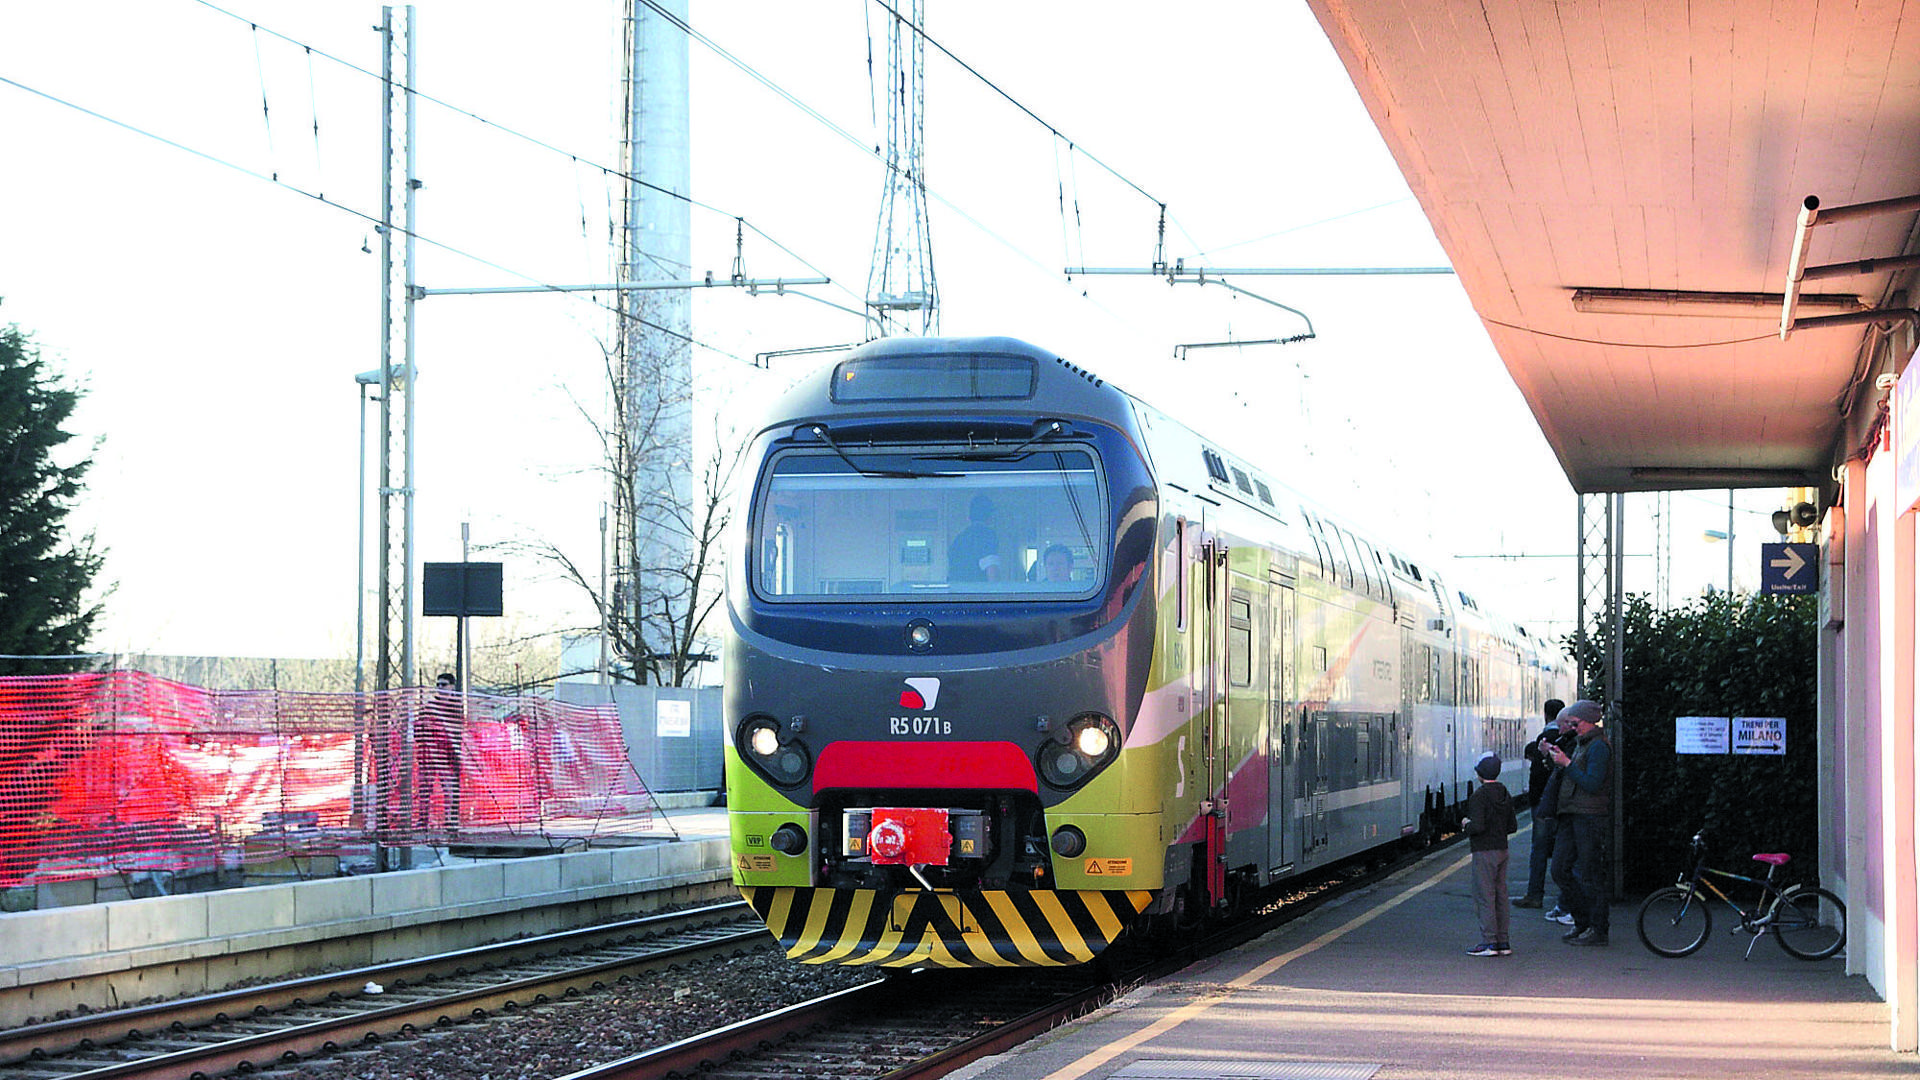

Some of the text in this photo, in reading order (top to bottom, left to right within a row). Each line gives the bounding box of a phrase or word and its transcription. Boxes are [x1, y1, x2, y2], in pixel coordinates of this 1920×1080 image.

[890, 717, 952, 735] R5 071 B
[1742, 721, 1779, 729] TRENI PER
[1738, 730, 1782, 741] MILANO
